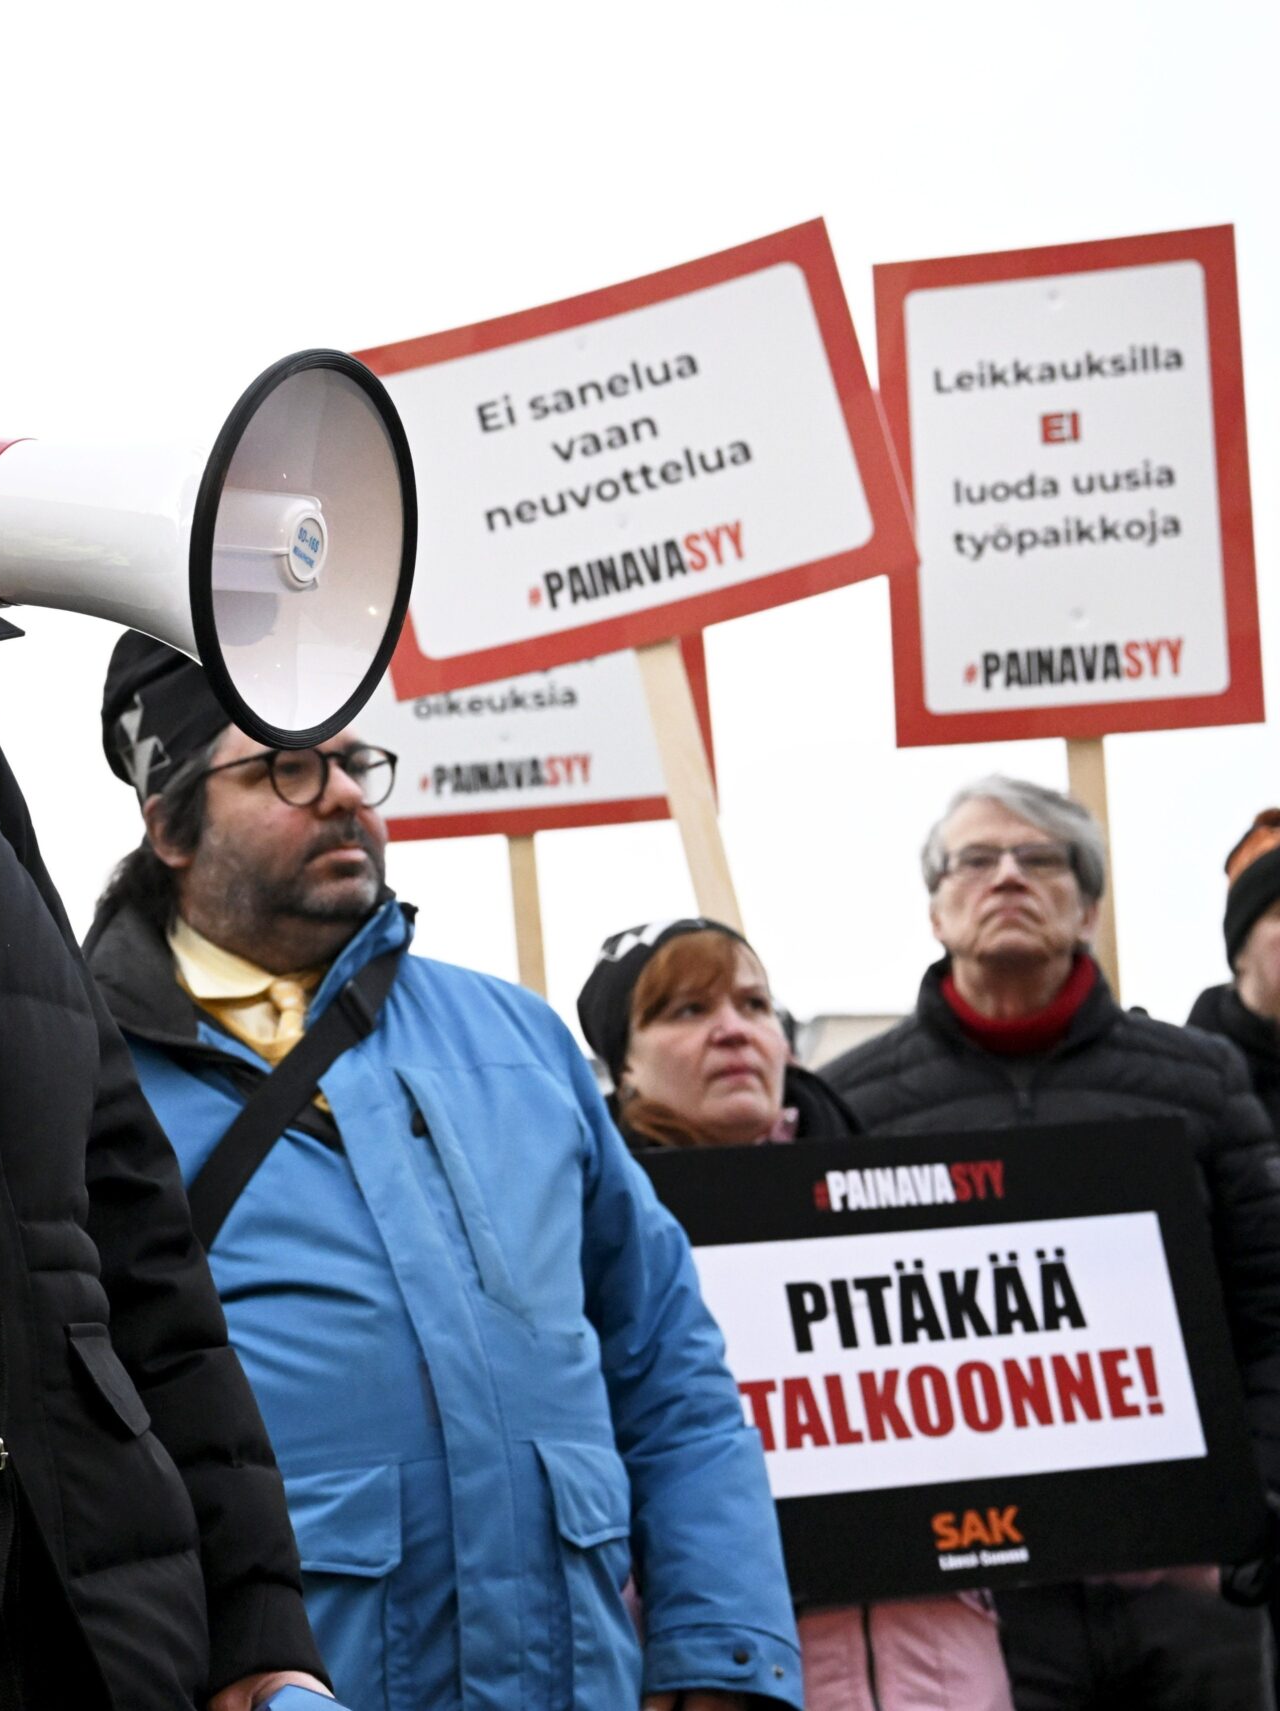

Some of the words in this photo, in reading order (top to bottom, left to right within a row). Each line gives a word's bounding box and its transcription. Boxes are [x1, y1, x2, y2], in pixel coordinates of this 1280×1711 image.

[476, 394, 517, 435] Ei
[528, 352, 700, 422] sanelua
[932, 344, 1185, 395] Leikkauksilla
[551, 411, 659, 463] vaan
[1039, 410, 1081, 446] EI
[483, 434, 754, 534] neuvottelua
[953, 472, 1060, 506] luoda
[1072, 459, 1177, 496] uusia
[953, 509, 1182, 561] työpaikkoja
[527, 519, 746, 610] #PAINAVASYY
[963, 637, 1184, 691] #PAINAVASYY
[419, 753, 592, 797] #PAINAVASYY
[813, 1160, 1006, 1213] #PAINAVASYY
[784, 1248, 1088, 1354] PITÄKÄÄ
[737, 1345, 1165, 1453] TALKOONNE!
[931, 1504, 1024, 1551] SAK
